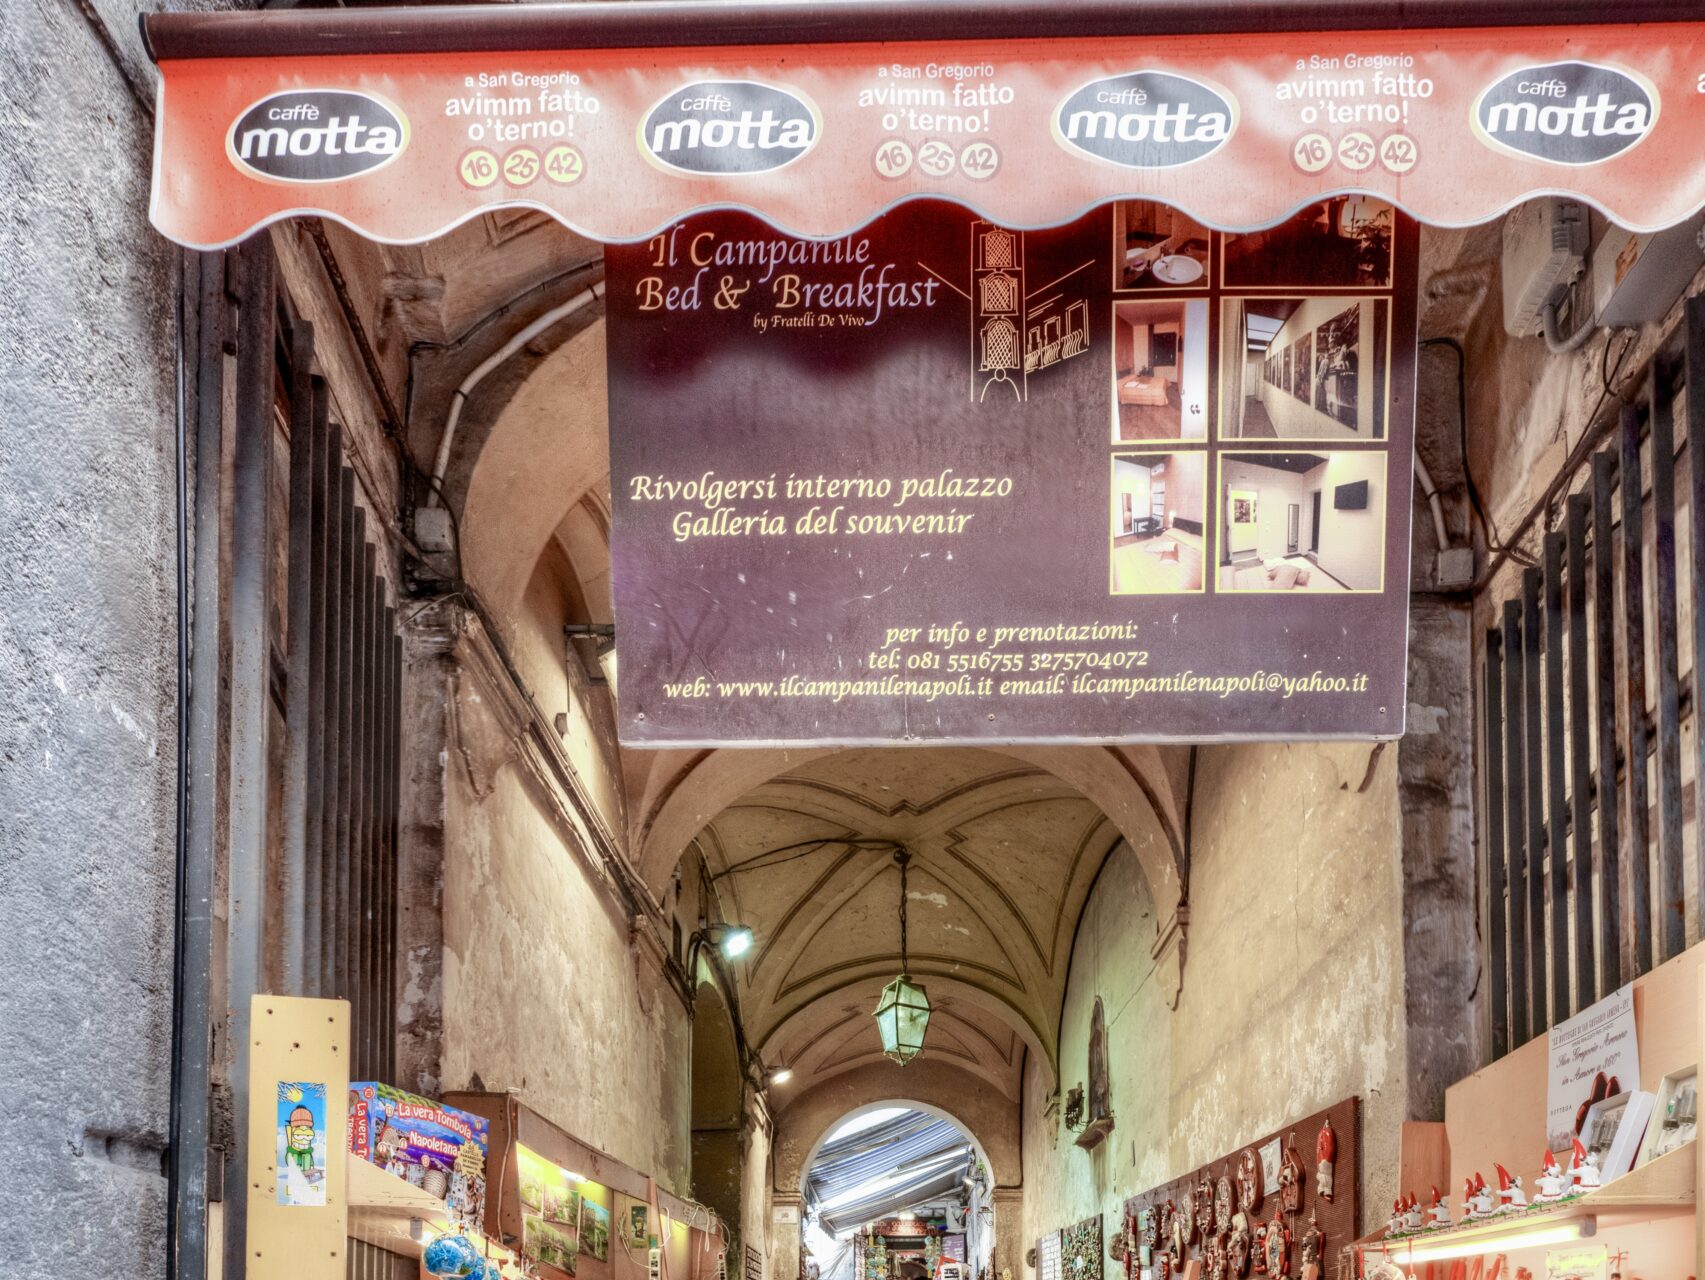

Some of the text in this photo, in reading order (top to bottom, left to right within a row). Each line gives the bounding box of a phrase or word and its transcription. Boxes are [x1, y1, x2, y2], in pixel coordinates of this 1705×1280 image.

[878, 62, 994, 80] a San Gregorio
[1296, 52, 1413, 70] a San Gregorio
[465, 72, 580, 88] a San Gregorio
[1276, 71, 1433, 100] avimm fatto
[1517, 79, 1567, 98] caffè
[446, 90, 600, 116] avimm fatto
[681, 95, 731, 112] caffè
[858, 83, 1014, 107] avimm fatto
[1097, 88, 1147, 105] caffè
[269, 104, 320, 120] caffè
[1068, 103, 1228, 142] motta
[1487, 93, 1649, 137] motta
[241, 115, 400, 159] motta
[653, 110, 812, 152] motta
[879, 145, 994, 171] 16 25 42
[1298, 137, 1413, 165] 16 25 42
[465, 152, 578, 180] 16 25 42
[649, 224, 869, 284] Il Campanile
[636, 264, 939, 326] Bed & Breakfast
[754, 313, 865, 333] by Fratelli De Vivo
[630, 469, 1012, 509] Rivolgersi interno palazzo
[672, 506, 972, 542] Galleria del souvenir
[881, 621, 1138, 649] per info e prenotazioni:
[868, 648, 1149, 672] tel: 081 5516755 3275704072
[663, 670, 1368, 701] web: www.ilcampanilenapoli.it email: ilcampanilenapoli@yahoo.it
[357, 1103, 366, 1116] La
[398, 1103, 472, 1138] La vera Tombola
[410, 1131, 458, 1156] Napoletana
